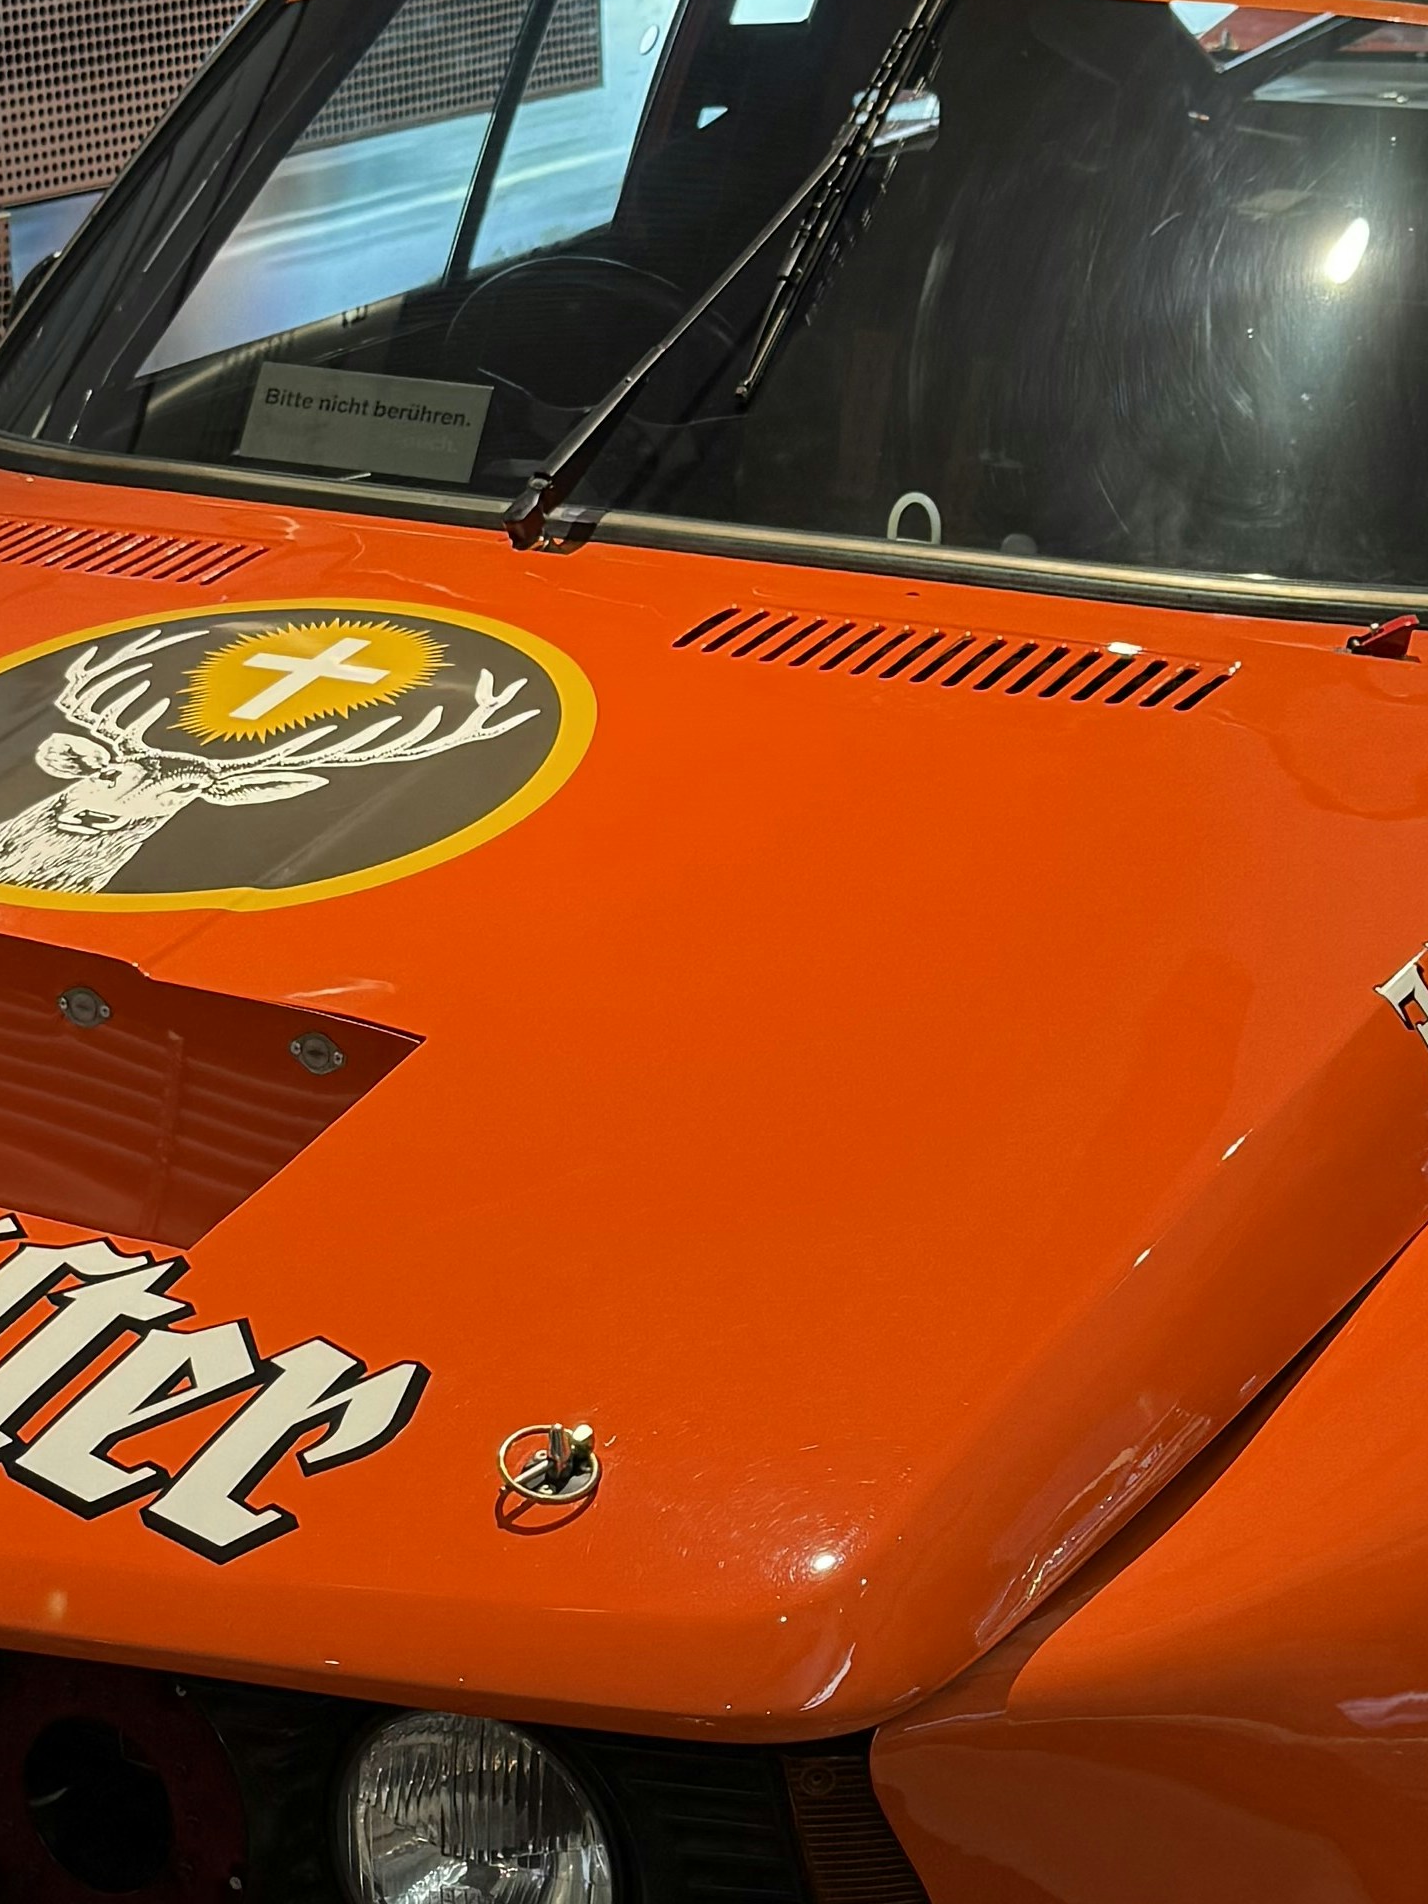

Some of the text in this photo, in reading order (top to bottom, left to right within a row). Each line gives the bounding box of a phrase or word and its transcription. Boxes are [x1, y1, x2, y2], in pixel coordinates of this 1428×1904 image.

[265, 387, 471, 428] Bitte nicht berühren.
